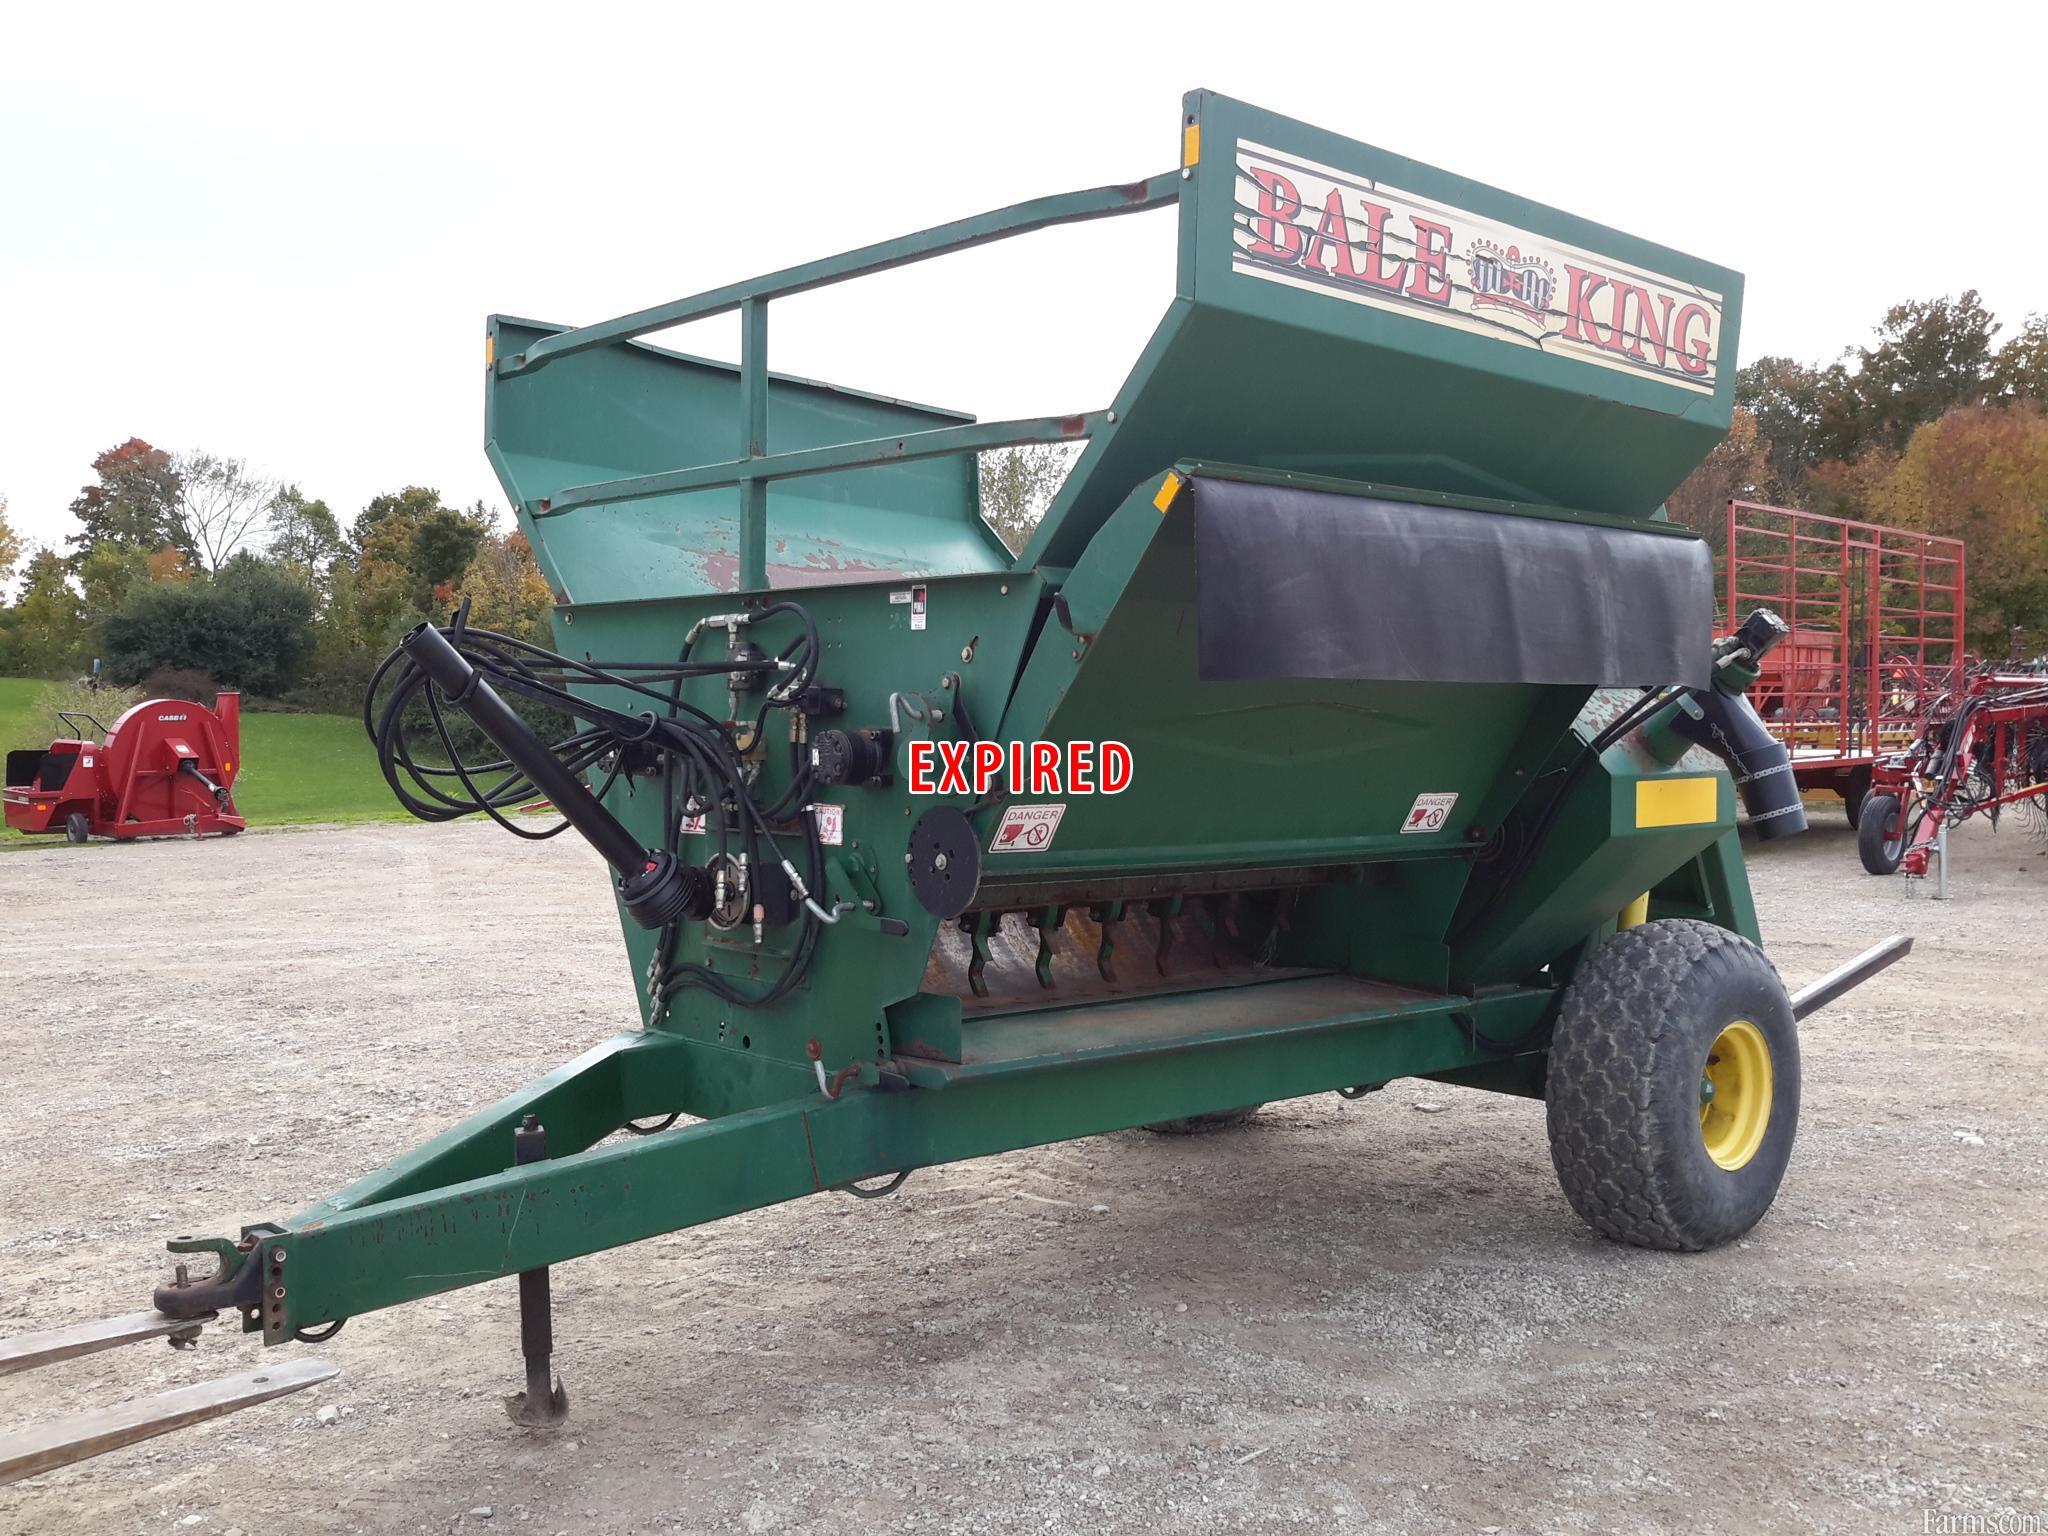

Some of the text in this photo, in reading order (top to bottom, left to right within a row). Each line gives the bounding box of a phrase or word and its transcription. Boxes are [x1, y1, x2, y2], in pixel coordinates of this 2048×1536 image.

[1248, 166, 1713, 375] BALE KING
[1416, 797, 1453, 807] DANGER
[1007, 810, 1059, 821] DANGER
